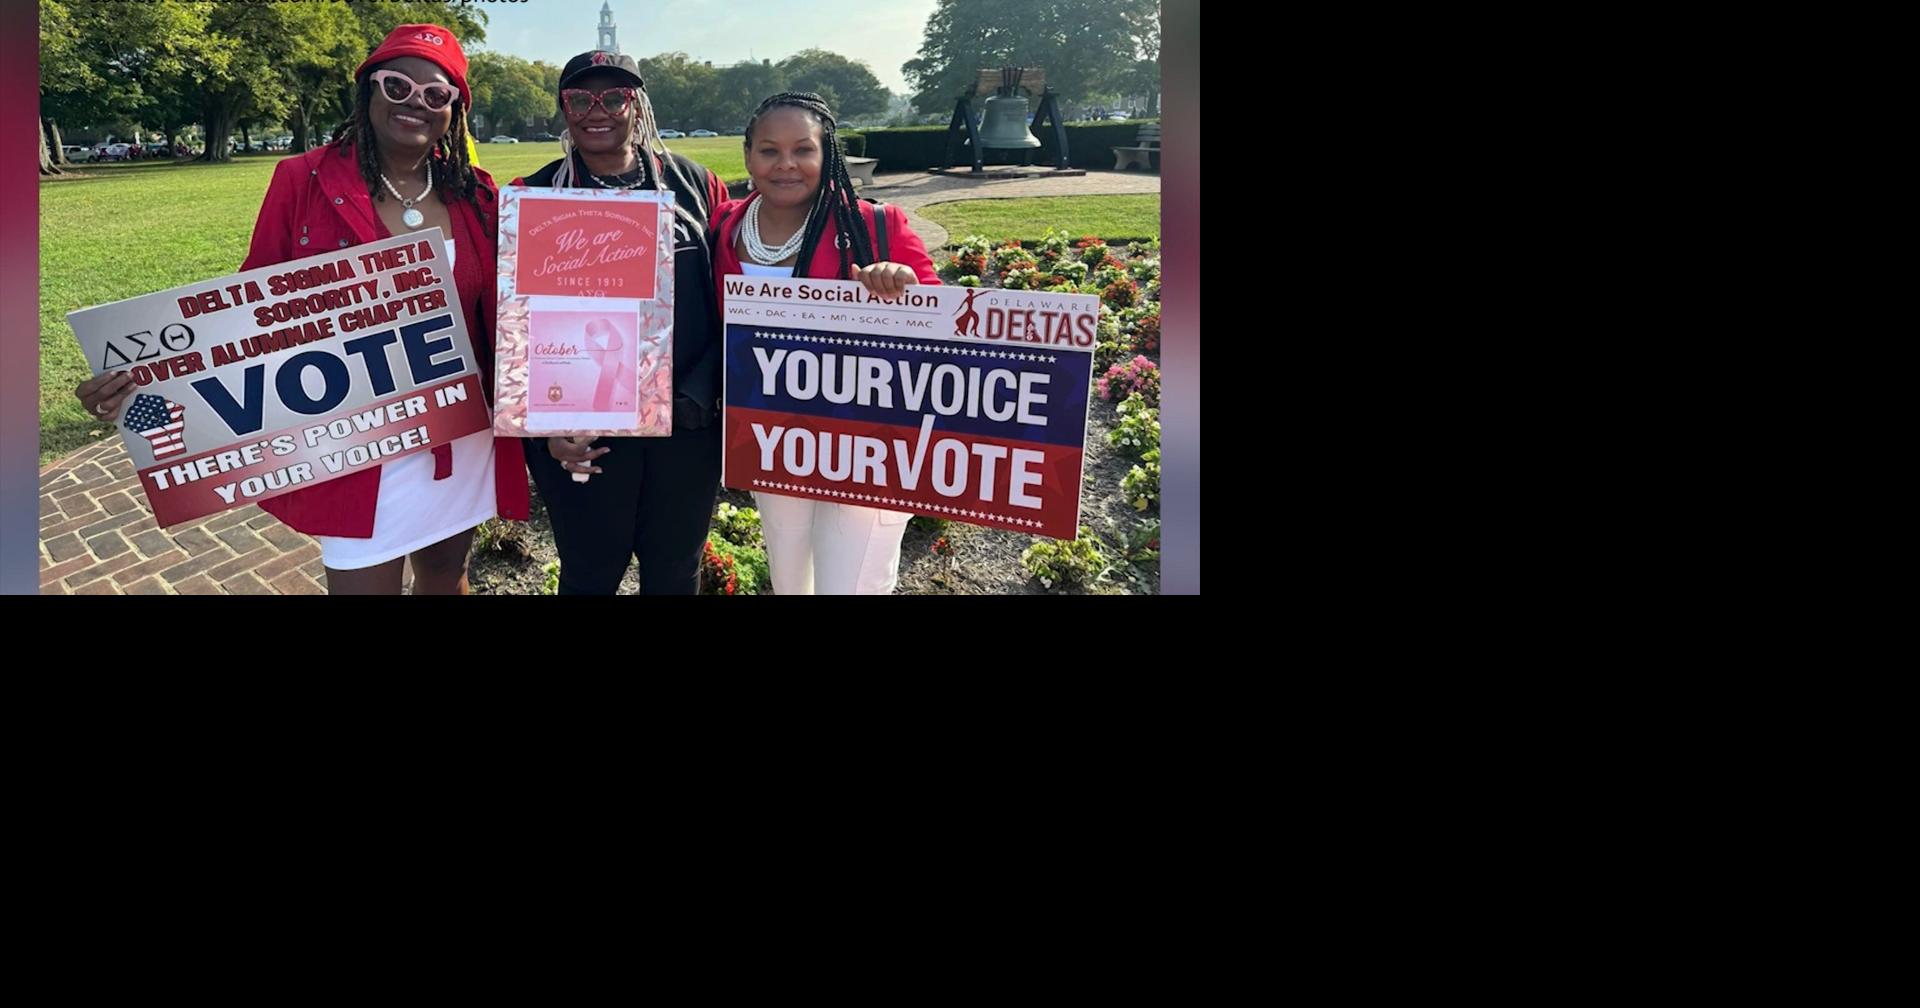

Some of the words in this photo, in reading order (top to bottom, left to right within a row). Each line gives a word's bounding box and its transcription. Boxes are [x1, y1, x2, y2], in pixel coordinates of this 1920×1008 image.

[533, 248, 589, 277] Social
[586, 244, 648, 267] Action
[555, 228, 588, 255] We
[592, 229, 624, 246] are
[178, 280, 265, 319] DELTA
[267, 259, 356, 296] SIGMA
[358, 240, 436, 275] THETA
[253, 279, 391, 328] SORORITY,
[392, 266, 443, 294] INC.
[556, 276, 591, 287] SINCE
[597, 278, 624, 288] 1913
[726, 280, 756, 297] We
[759, 282, 793, 299] Are
[797, 284, 862, 303] Social
[728, 307, 751, 316] WAC
[765, 309, 787, 318] DAC
[801, 311, 816, 320] EA
[859, 315, 889, 326] SCAC
[906, 319, 934, 329] MAC
[985, 307, 1096, 348] DELTAS
[989, 297, 1091, 312] DELAWARE
[103, 322, 196, 370] ΔΣΘ
[118, 351, 207, 387] OVER
[210, 317, 336, 367] ALUMNAE
[338, 289, 449, 333] CHAPTER
[535, 342, 580, 356] October
[189, 314, 467, 438] VOTE
[752, 346, 894, 409] YOUR
[898, 360, 1050, 427] VOICE
[302, 394, 430, 449] POWER
[434, 382, 469, 409] IN
[213, 461, 316, 505] YOUR
[320, 425, 433, 475] VOICE!
[750, 422, 887, 488] YOUR
[892, 413, 1045, 510] VOTE
